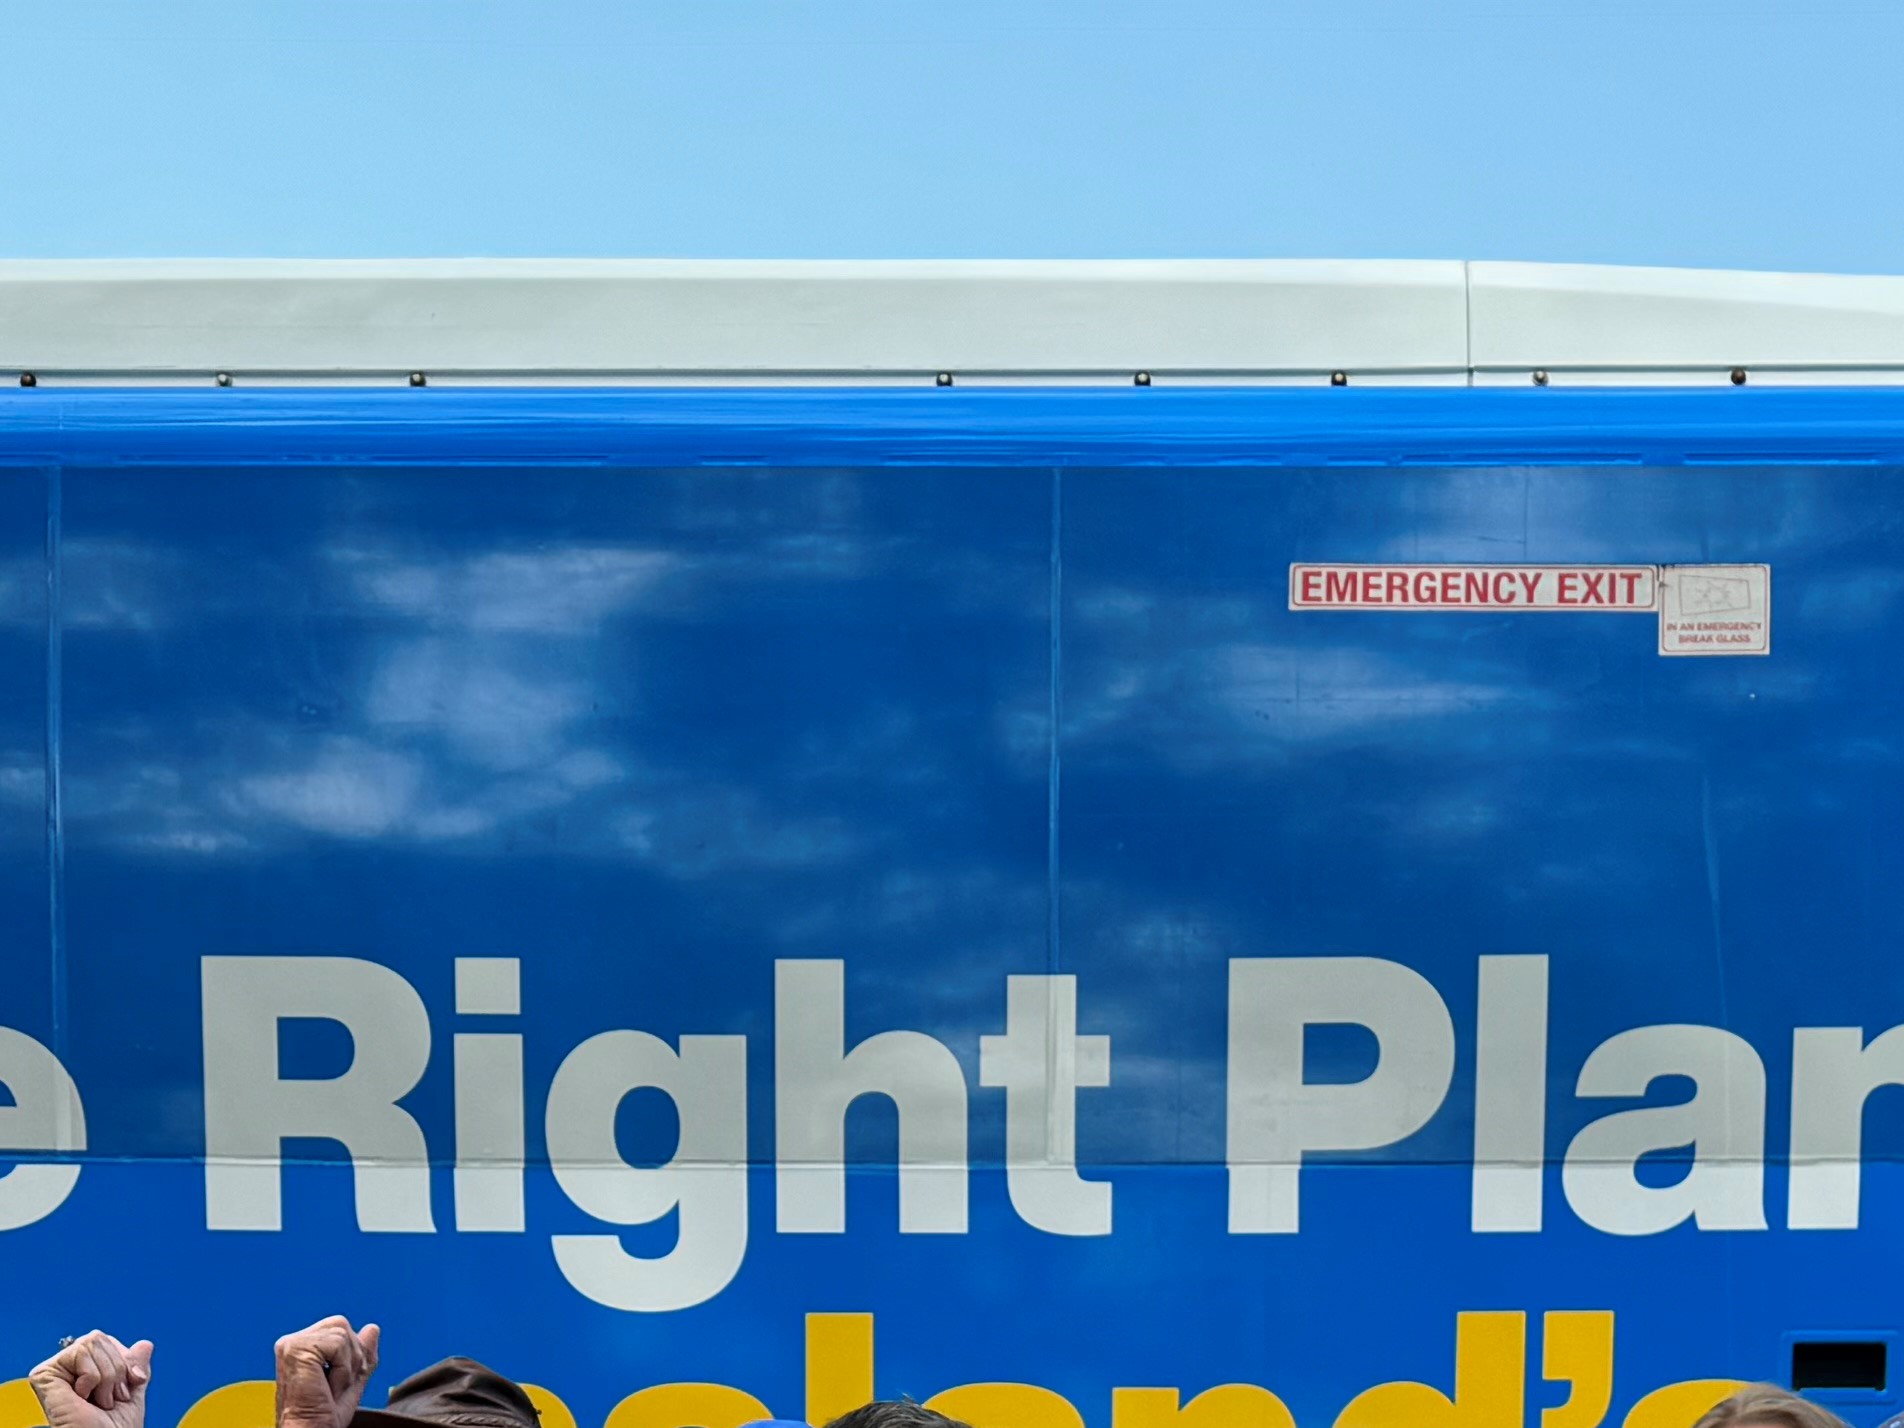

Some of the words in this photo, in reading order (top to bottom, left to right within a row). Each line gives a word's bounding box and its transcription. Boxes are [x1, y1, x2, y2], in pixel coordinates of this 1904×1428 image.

[1300, 570, 1542, 604] EMERGENCY
[1556, 571, 1643, 605] EXIT
[1679, 633, 1713, 644] BREAK
[1716, 633, 1750, 643] GLASS
[1697, 622, 1762, 632] EMERGENCY
[198, 954, 1111, 1312] Right
